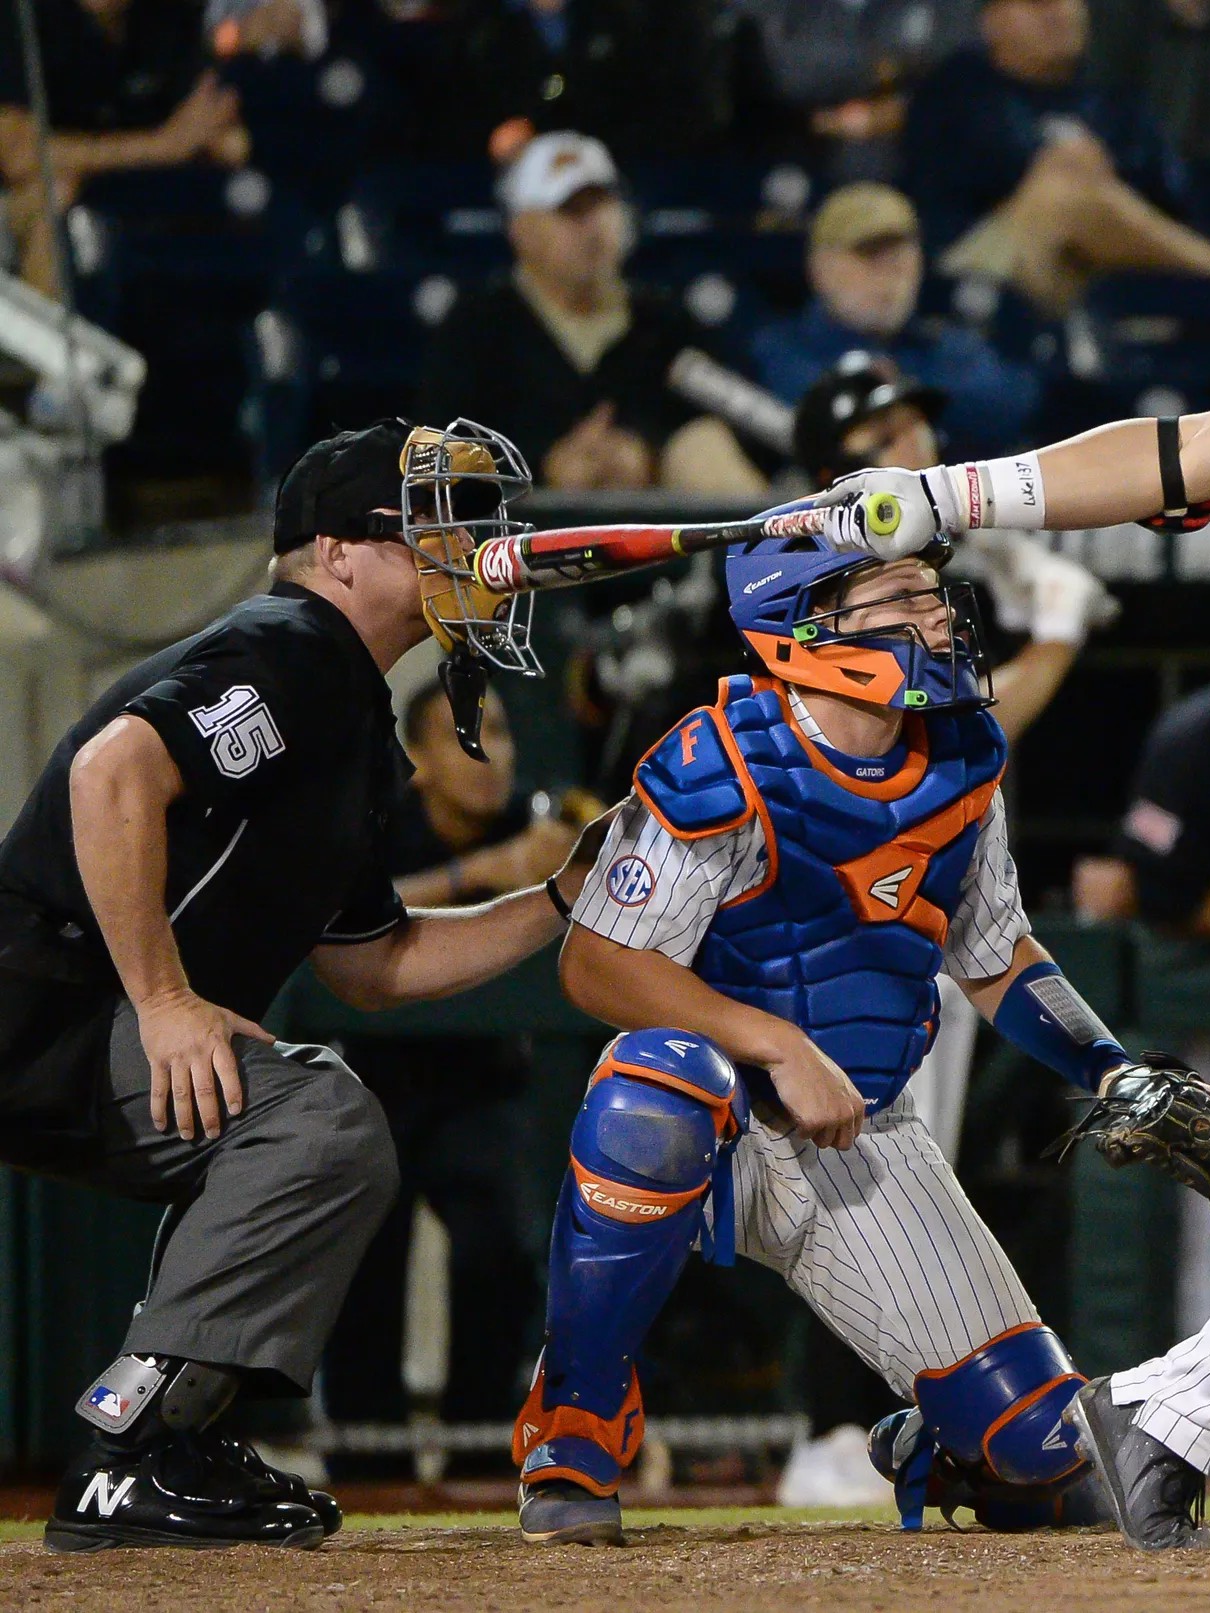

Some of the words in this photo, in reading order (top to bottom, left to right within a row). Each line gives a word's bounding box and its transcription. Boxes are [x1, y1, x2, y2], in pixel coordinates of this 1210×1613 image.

[751, 570, 782, 591] EASTON
[187, 685, 286, 779] 15
[680, 719, 702, 767] F
[855, 767, 885, 777] GATORS
[610, 857, 652, 903] SEC
[591, 1192, 668, 1216] EASTON
